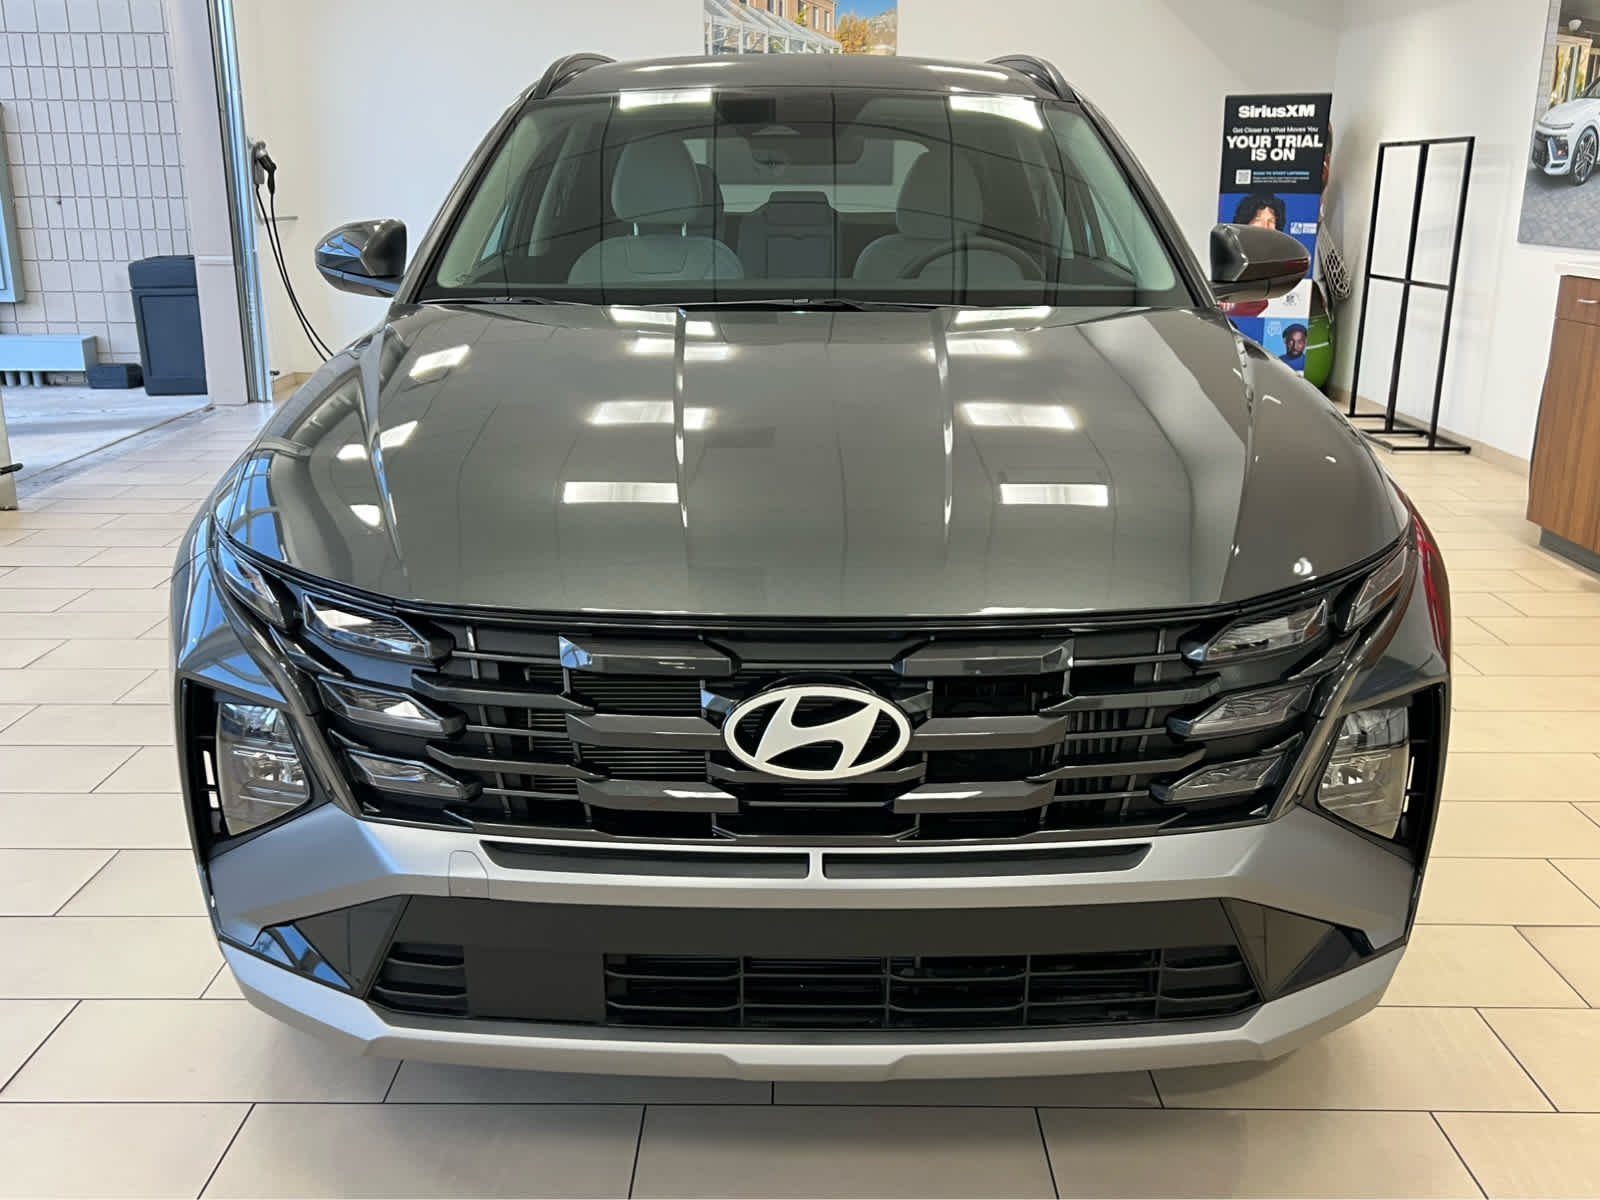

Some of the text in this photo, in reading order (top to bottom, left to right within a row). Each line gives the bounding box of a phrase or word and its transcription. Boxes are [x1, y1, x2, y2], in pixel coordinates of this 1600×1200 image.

[1238, 104, 1315, 118] SiriusXM
[1226, 134, 1323, 149] YOUR TRIAL
[1251, 148, 1296, 161] IS ON
